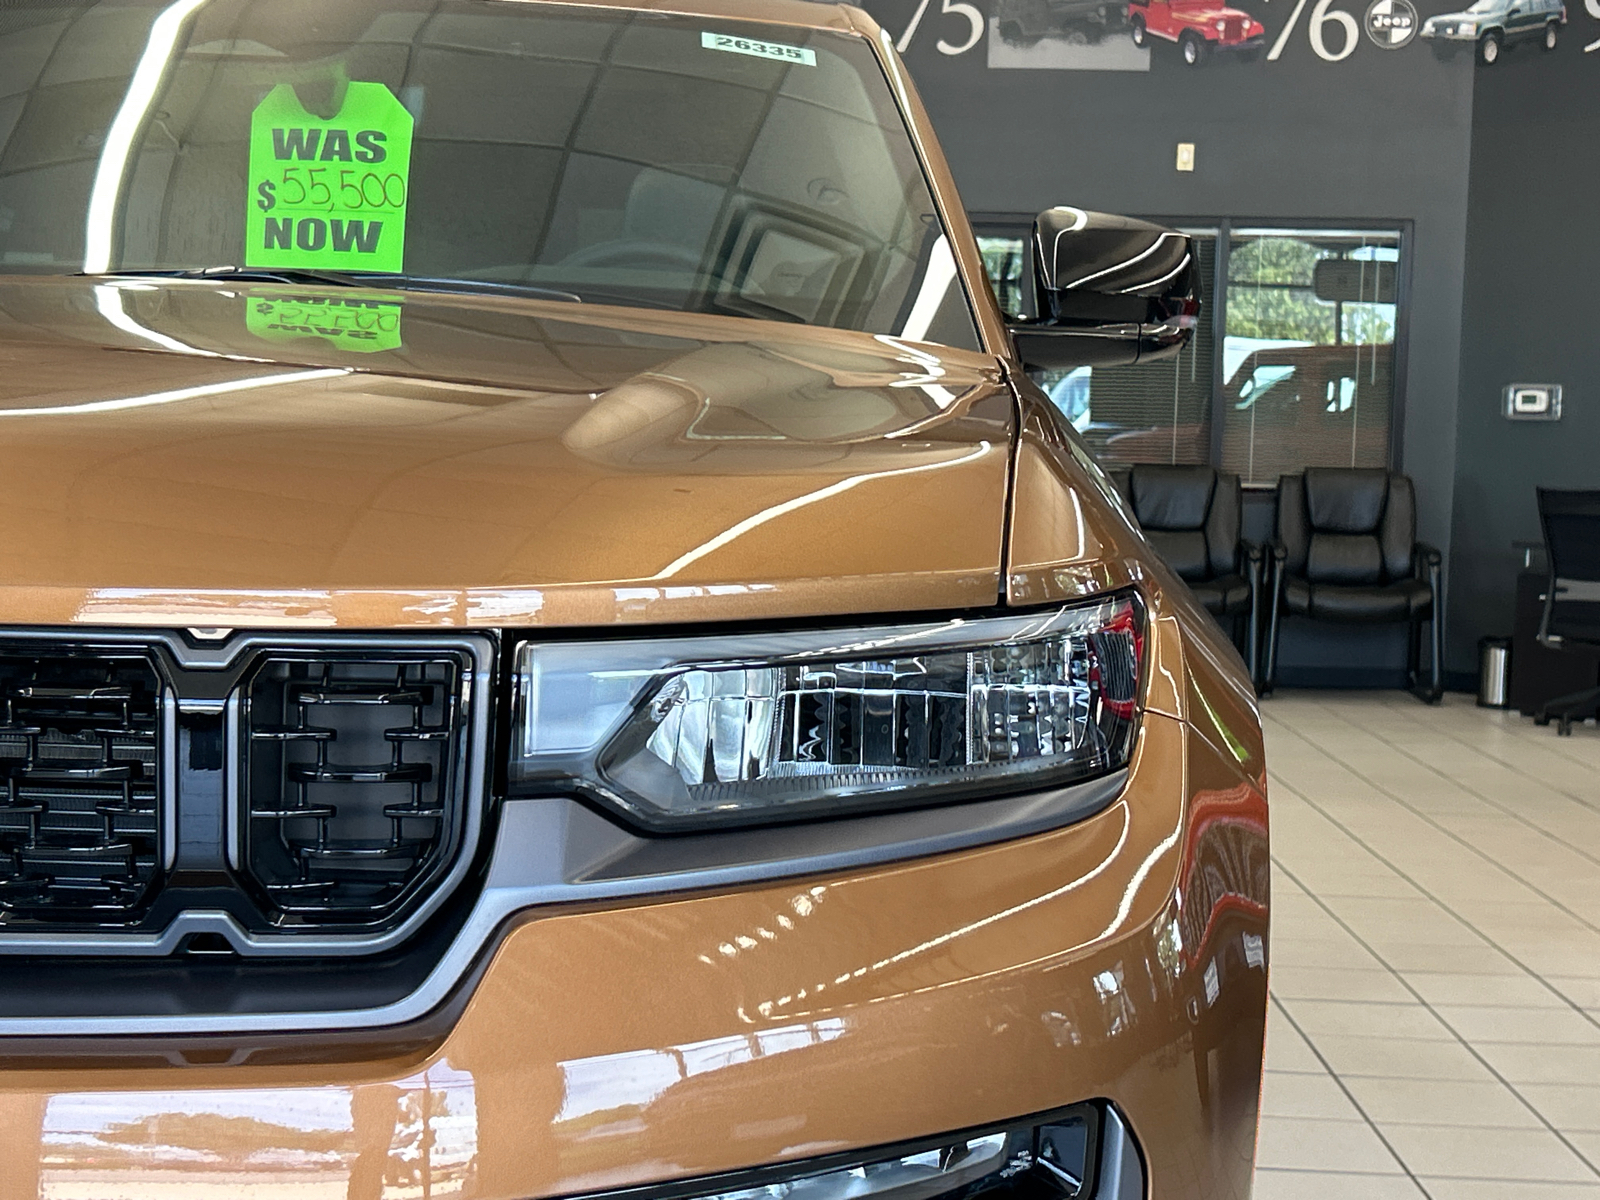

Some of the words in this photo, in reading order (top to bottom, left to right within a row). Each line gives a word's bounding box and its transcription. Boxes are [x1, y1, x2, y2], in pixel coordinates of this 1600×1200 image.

[1373, 14, 1411, 28] Jeep
[716, 37, 802, 59] 26335
[271, 128, 388, 164] WAS
[263, 217, 384, 253] NOW
